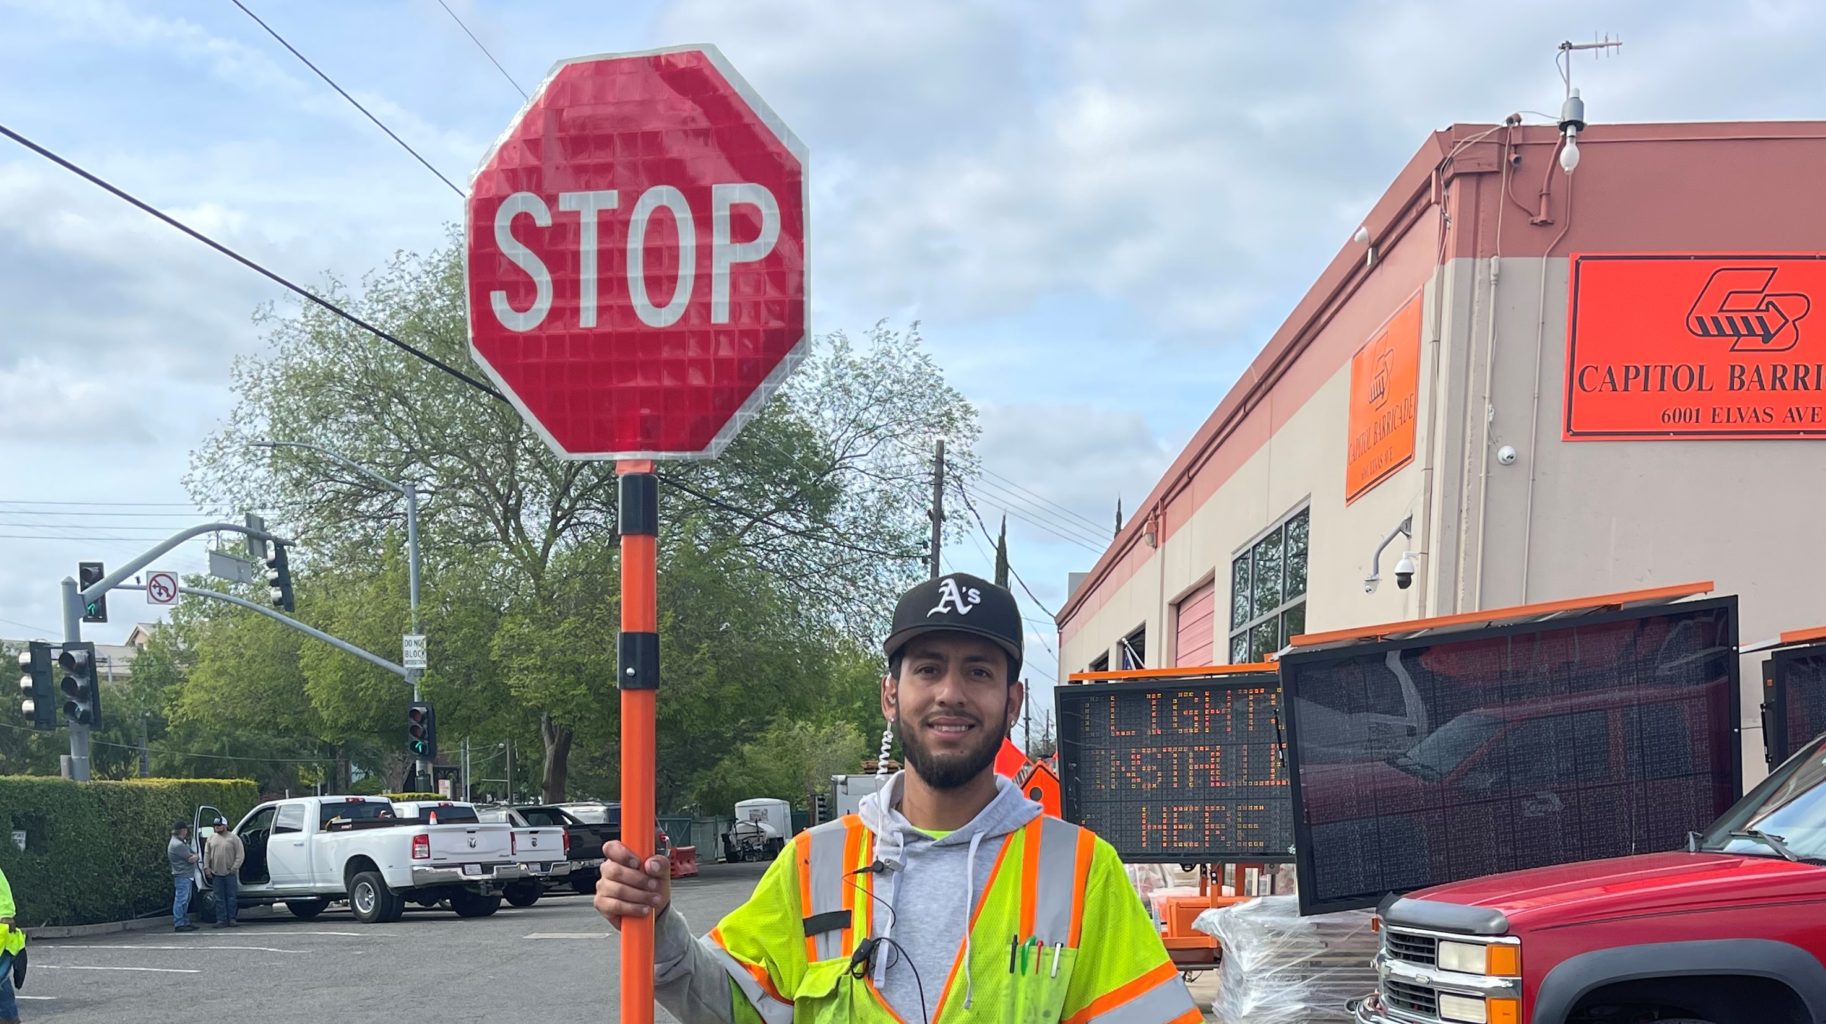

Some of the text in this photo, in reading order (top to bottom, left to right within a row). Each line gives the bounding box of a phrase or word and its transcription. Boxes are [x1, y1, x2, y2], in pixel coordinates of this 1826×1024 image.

[490, 182, 781, 332] STOP
[1578, 363, 1714, 393] CAPITOL
[1661, 406, 1822, 424] 6001 ELVAS AVE
[926, 578, 981, 618] A's
[404, 639, 413, 647] DO
[1141, 804, 1265, 848] HERE
